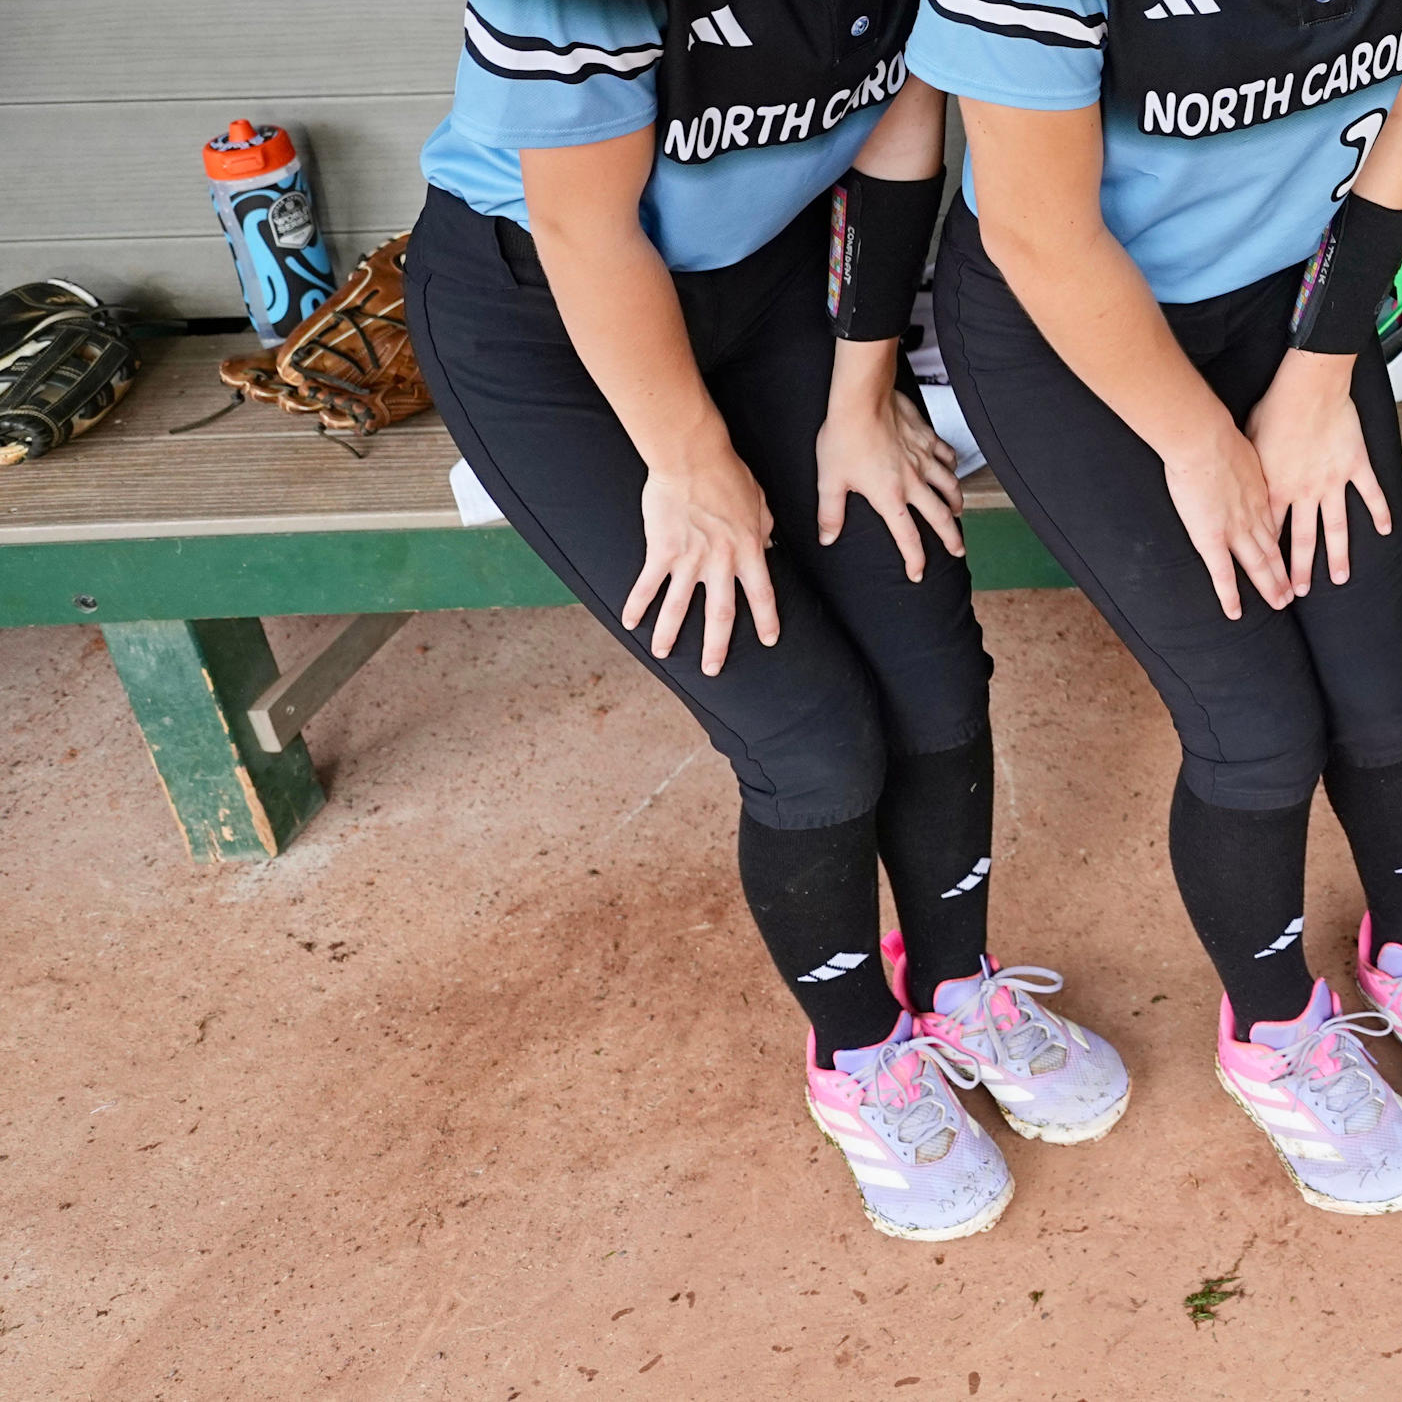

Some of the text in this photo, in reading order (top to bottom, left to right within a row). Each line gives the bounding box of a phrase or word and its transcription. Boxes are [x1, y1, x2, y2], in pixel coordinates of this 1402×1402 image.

[663, 98, 816, 162] NORTH
[1143, 73, 1294, 137] NORTH
[1318, 234, 1337, 285] ATTACK
